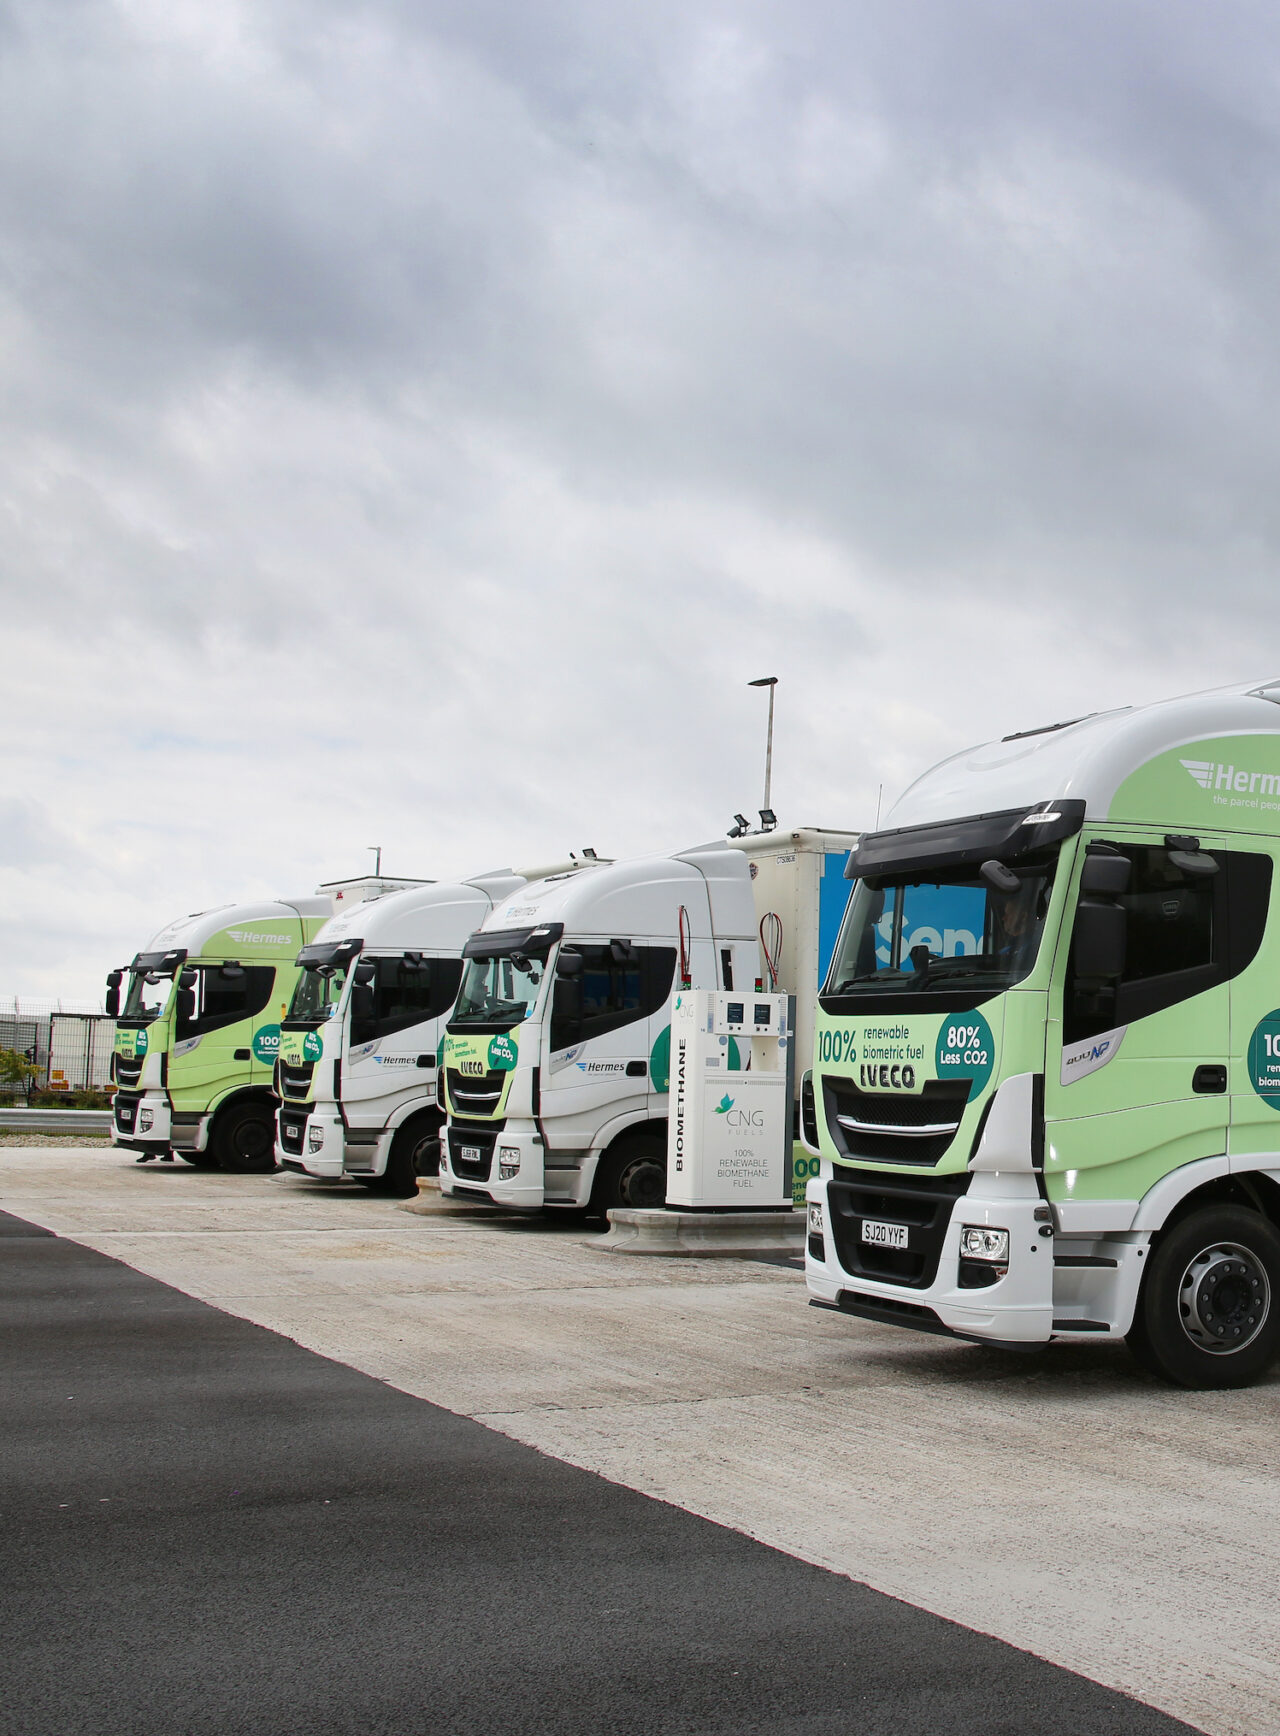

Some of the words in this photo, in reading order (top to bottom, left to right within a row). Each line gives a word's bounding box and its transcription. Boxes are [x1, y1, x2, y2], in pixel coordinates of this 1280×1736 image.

[1213, 794, 1228, 805] the
[1230, 797, 1259, 808] parcel
[242, 931, 292, 945] Hermes
[875, 911, 984, 964] Sen
[258, 1036, 280, 1046] 100
[818, 1029, 857, 1063] 100%
[863, 1025, 910, 1040] renewable
[946, 1025, 981, 1049] 80%
[863, 1044, 904, 1060] biometric
[906, 1044, 925, 1060] fuel
[940, 1050, 961, 1065] Less
[963, 1050, 988, 1065] CO2
[383, 1056, 417, 1064] Hermes
[587, 1062, 625, 1072] Hermes
[461, 1061, 483, 1075] IVECO
[860, 1063, 916, 1089] IVECO
[675, 1038, 686, 1172] BIOMETHANE
[726, 1110, 764, 1127] CNG
[734, 1149, 754, 1157] 100%
[719, 1159, 768, 1168] RENEWABLE
[795, 1157, 820, 1177] 00
[717, 1169, 769, 1178] BIOMETHANE
[733, 1180, 754, 1188] FUEL
[865, 1224, 887, 1242] SJ20
[888, 1227, 905, 1244] YYF
